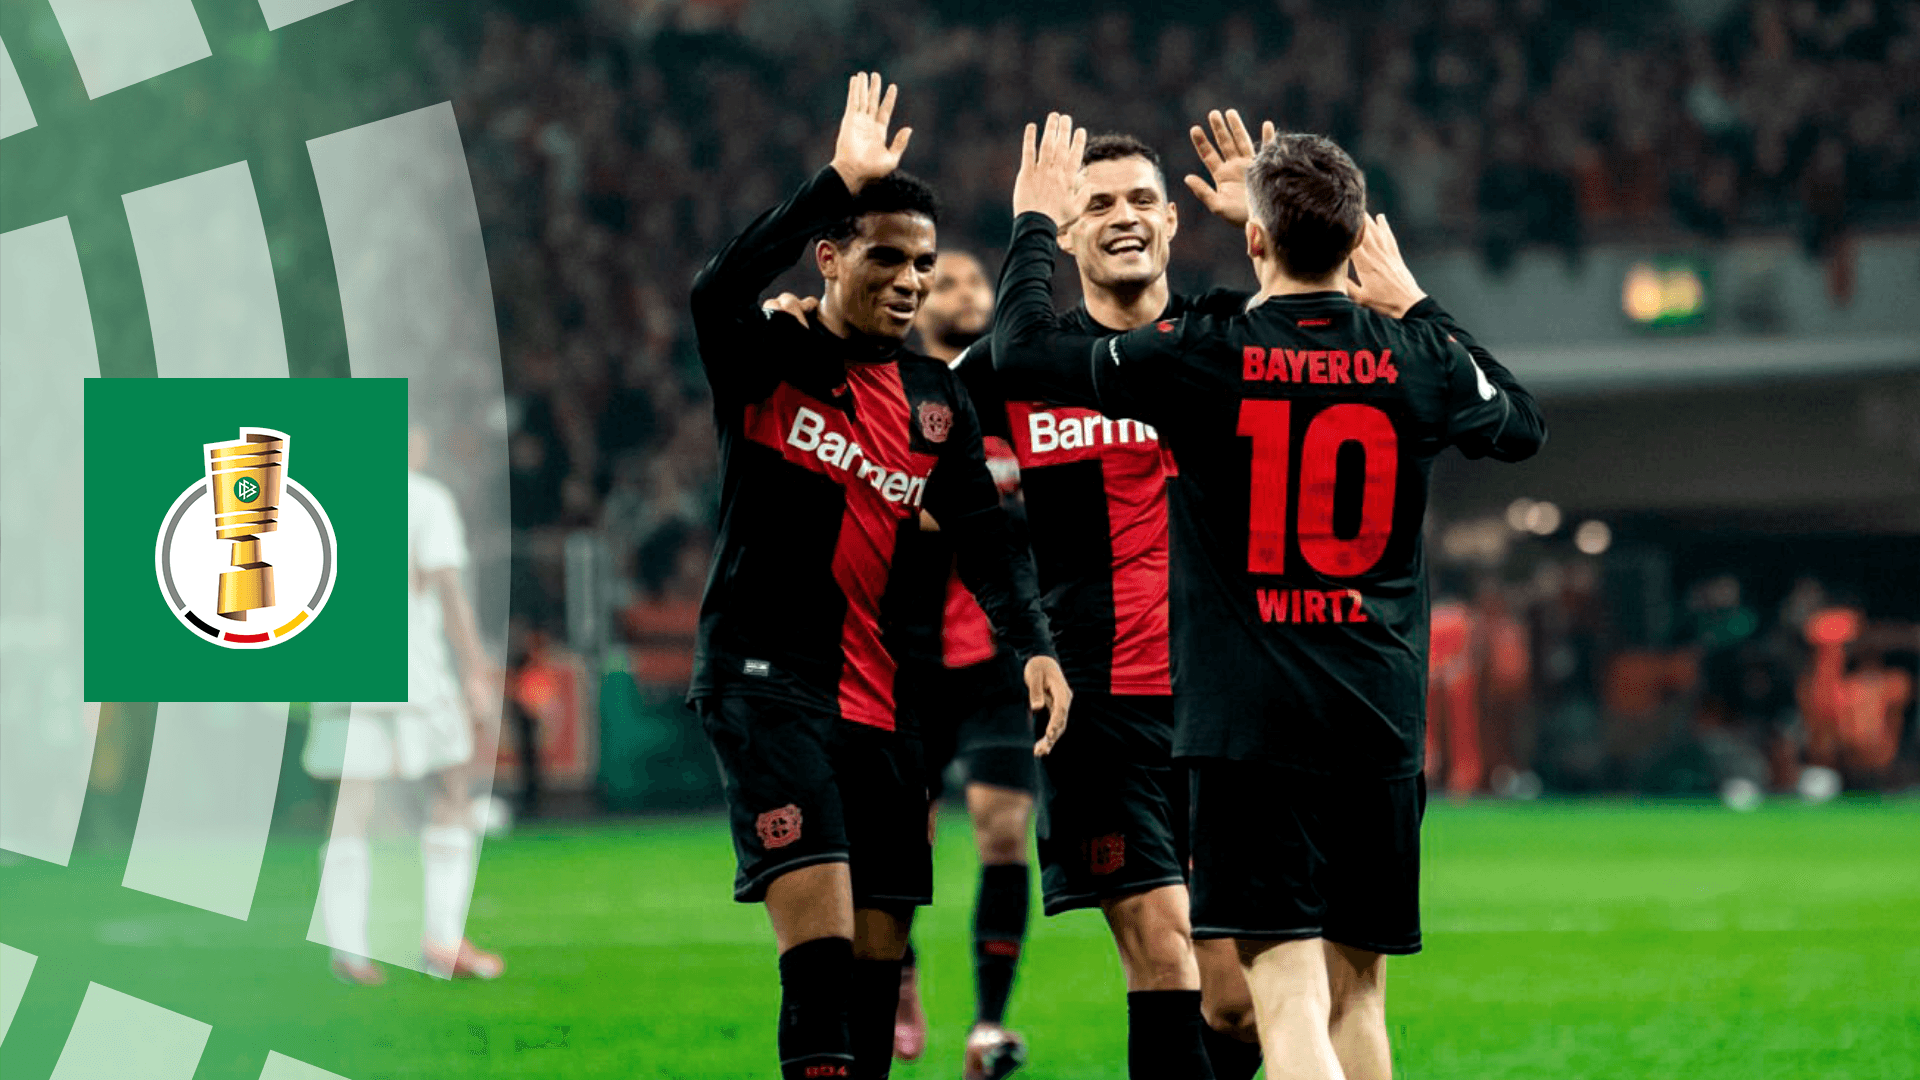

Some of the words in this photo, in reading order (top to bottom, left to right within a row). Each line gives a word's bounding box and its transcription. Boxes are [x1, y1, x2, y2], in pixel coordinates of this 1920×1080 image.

[1243, 345, 1351, 384] BAYER
[1353, 348, 1399, 384] 04
[1236, 399, 1398, 577] 10
[1256, 588, 1368, 623] WIRTZ
